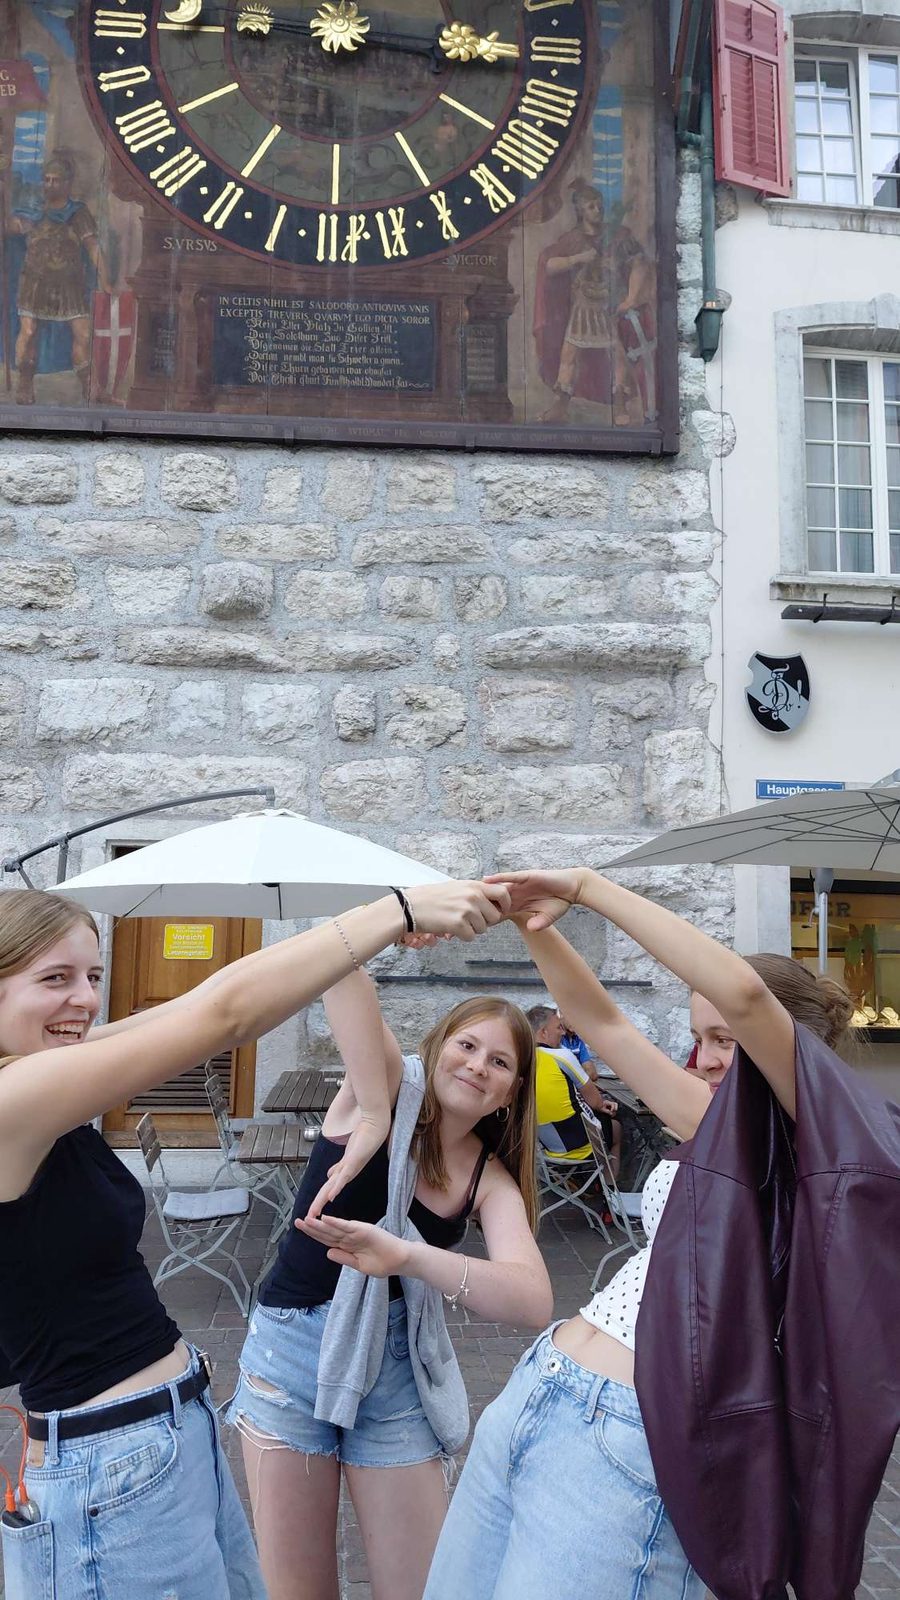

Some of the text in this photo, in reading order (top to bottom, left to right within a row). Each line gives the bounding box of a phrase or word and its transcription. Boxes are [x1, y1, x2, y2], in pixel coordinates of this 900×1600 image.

[219, 296, 229, 305] IN
[232, 296, 261, 306] CELTIS
[263, 298, 290, 308] NIHIL
[291, 300, 305, 309] EST
[408, 305, 430, 314] VNIS
[220, 308, 263, 318] EXCEPTIS
[375, 315, 398, 323] DICTA
